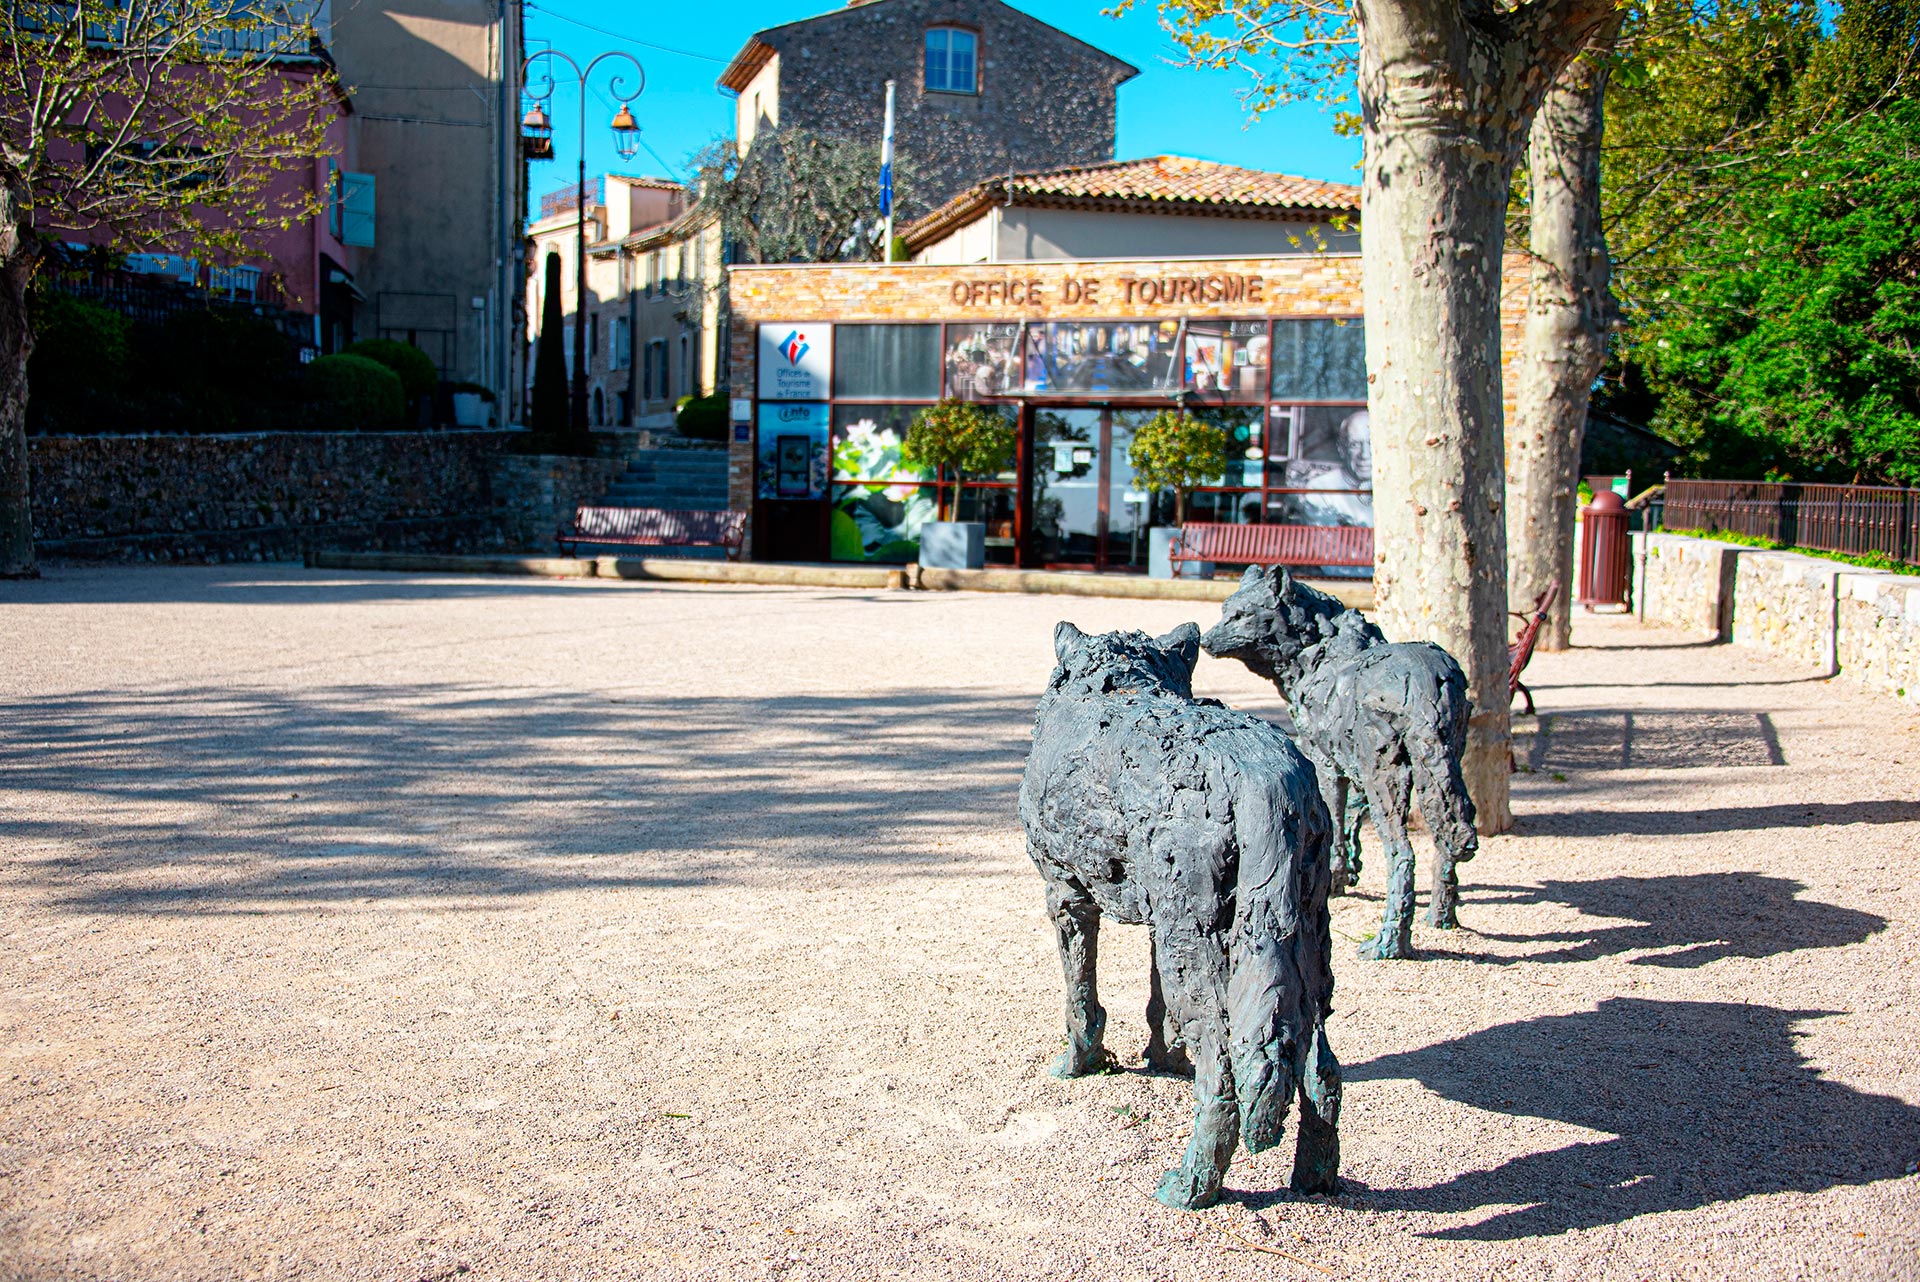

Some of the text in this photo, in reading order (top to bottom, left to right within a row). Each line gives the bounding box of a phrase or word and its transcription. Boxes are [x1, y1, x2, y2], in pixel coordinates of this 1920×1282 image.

[950, 274, 1263, 307] OFFICE DE TOURISME
[776, 378, 811, 388] Tourisme
